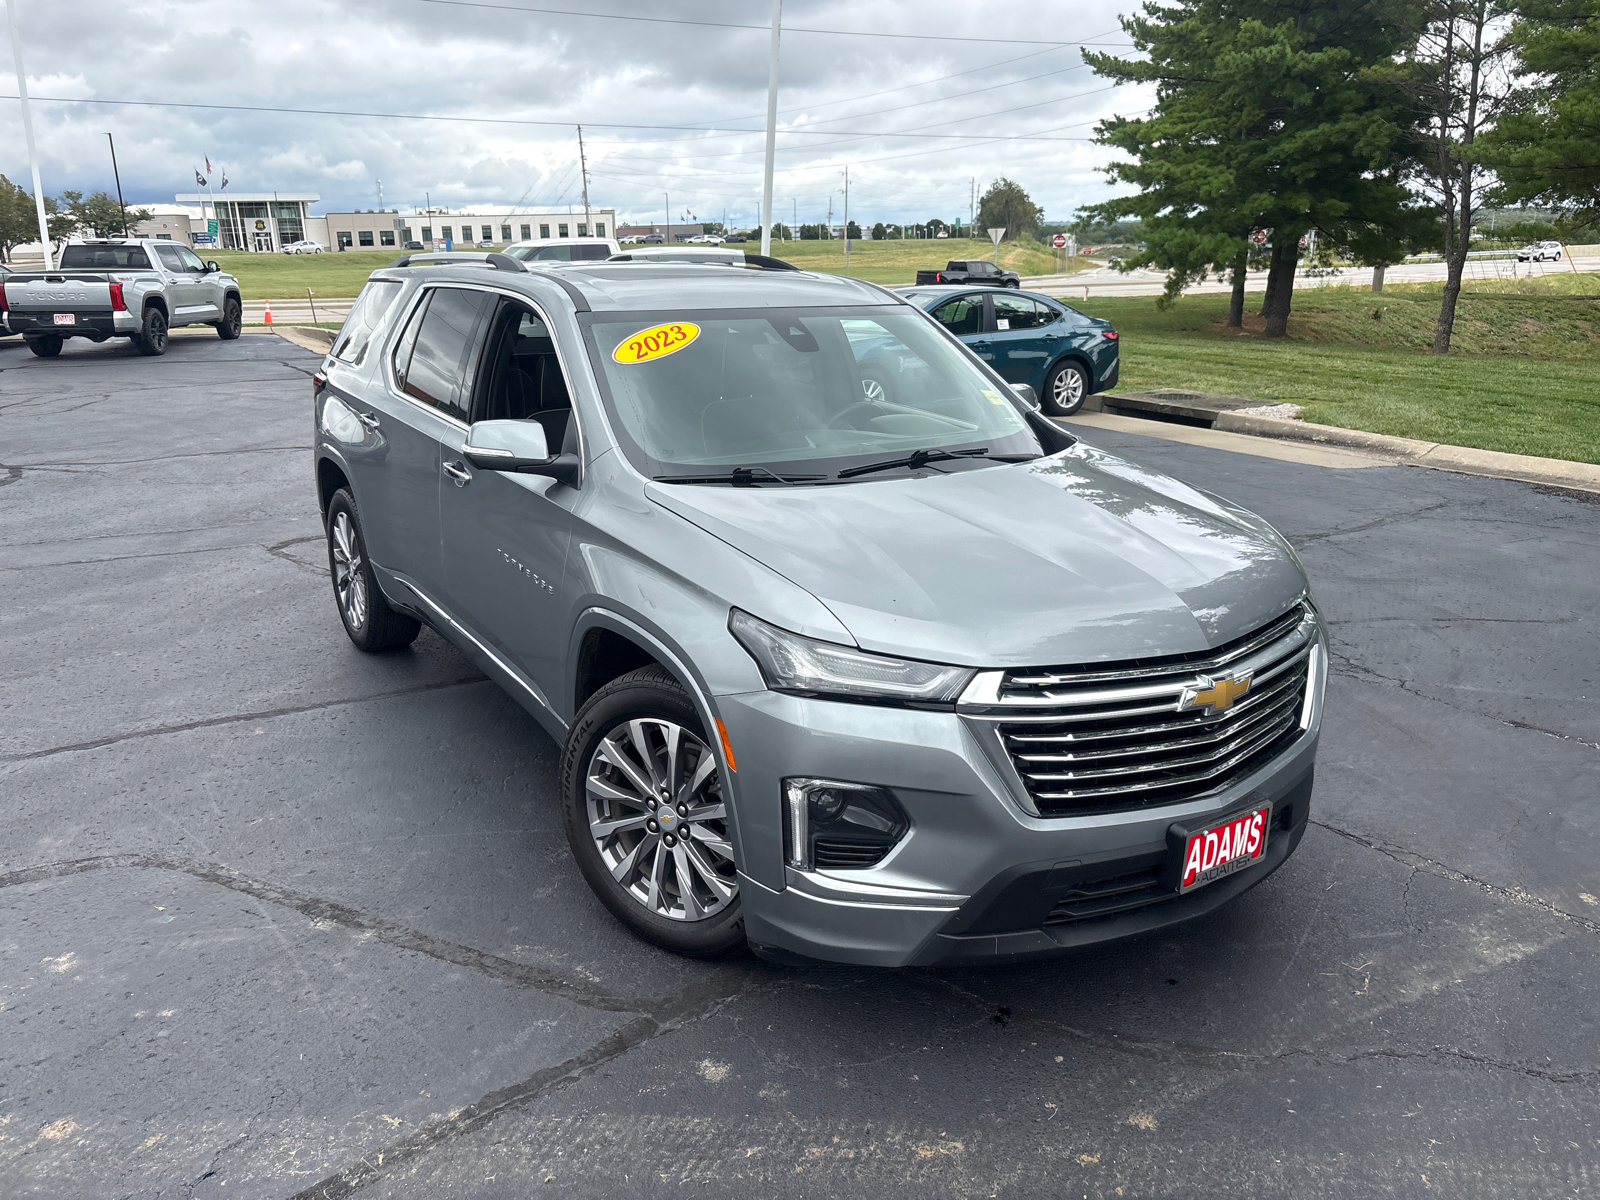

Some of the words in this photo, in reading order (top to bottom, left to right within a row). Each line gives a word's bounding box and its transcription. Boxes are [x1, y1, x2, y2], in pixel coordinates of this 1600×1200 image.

[26, 292, 88, 301] TUNDRA
[629, 325, 687, 360] 2023
[1184, 814, 1262, 880] ADAMS
[1201, 856, 1247, 883] ADAMS
